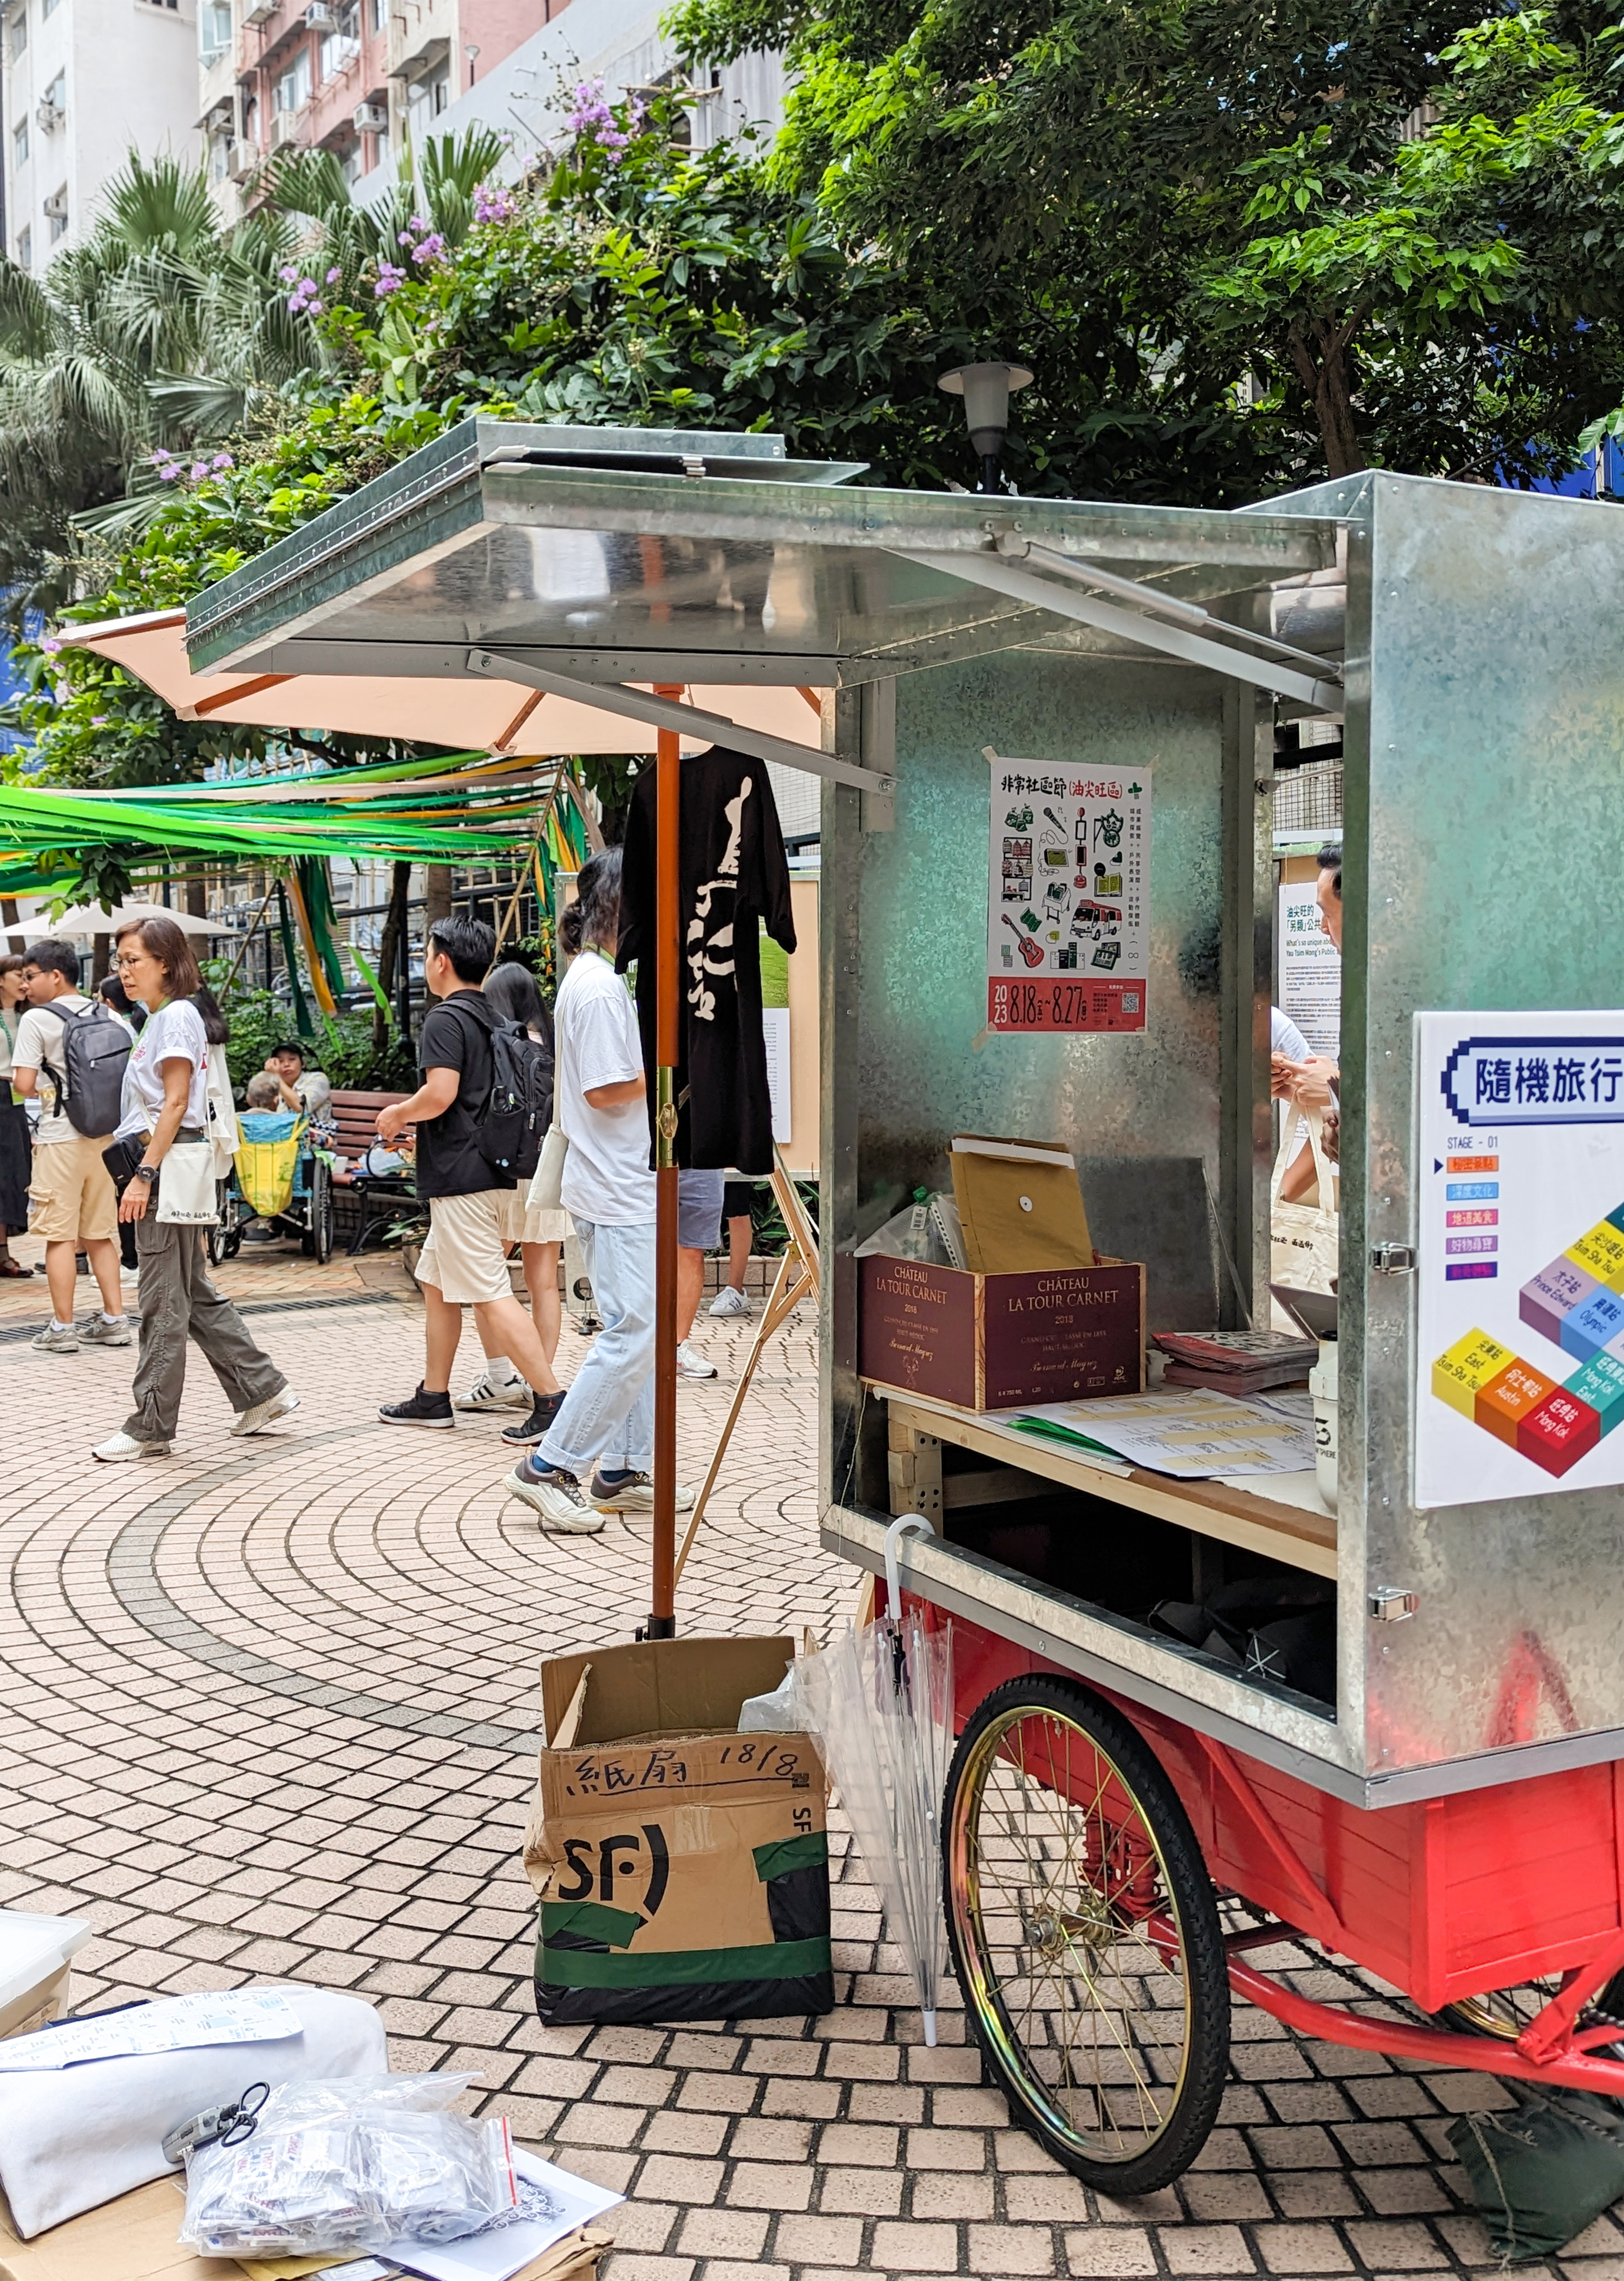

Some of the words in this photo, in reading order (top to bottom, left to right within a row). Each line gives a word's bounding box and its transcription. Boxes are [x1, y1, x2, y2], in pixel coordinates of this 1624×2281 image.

[1001, 774, 1066, 799] 非常社區節
[1287, 904, 1314, 917] 油尖旺的
[1305, 947, 1321, 958] Mong's
[1307, 938, 1322, 947] unique
[995, 985, 1007, 1002] 20
[994, 1005, 1007, 1024] 23
[1476, 1057, 1623, 1105] 隨機旅行
[1448, 1136, 1473, 1149] STAGE
[1488, 1136, 1498, 1148] 01
[1452, 1210, 1492, 1225] 地道美食
[1573, 1238, 1589, 1255] Tsim
[1587, 1250, 1602, 1264] Sha
[1600, 1259, 1619, 1274] Tsui
[894, 1266, 928, 1283] CHÂTEAU
[1037, 1276, 1089, 1292] CHÂTEAU
[1530, 1275, 1553, 1294] Prince
[1551, 1271, 1581, 1294] 太子站
[876, 1277, 886, 1291] LA
[887, 1279, 911, 1296] TOUR
[913, 1285, 947, 1304] CARNET
[1009, 1299, 1024, 1312] LA
[1027, 1295, 1064, 1310] TOUR
[1067, 1290, 1119, 1307] CARNET
[1580, 1310, 1607, 1333] Olympic
[1476, 1340, 1503, 1360] 尖東站
[1436, 1354, 1453, 1371] Tsim
[1451, 1366, 1466, 1381] Sha
[1464, 1352, 1487, 1370] East
[1505, 1368, 1543, 1398] 柯士甸站
[1581, 1367, 1603, 1389] Mong
[1598, 1379, 1616, 1395] Kok
[1495, 1385, 1522, 1406] Austin
[1575, 1385, 1596, 1403] East
[1549, 1398, 1579, 1423] 旺角站
[1534, 1411, 1557, 1433] Mong
[1553, 1423, 1570, 1439] Kok
[720, 1743, 798, 1776] 18/8
[792, 1807, 812, 1832] SF
